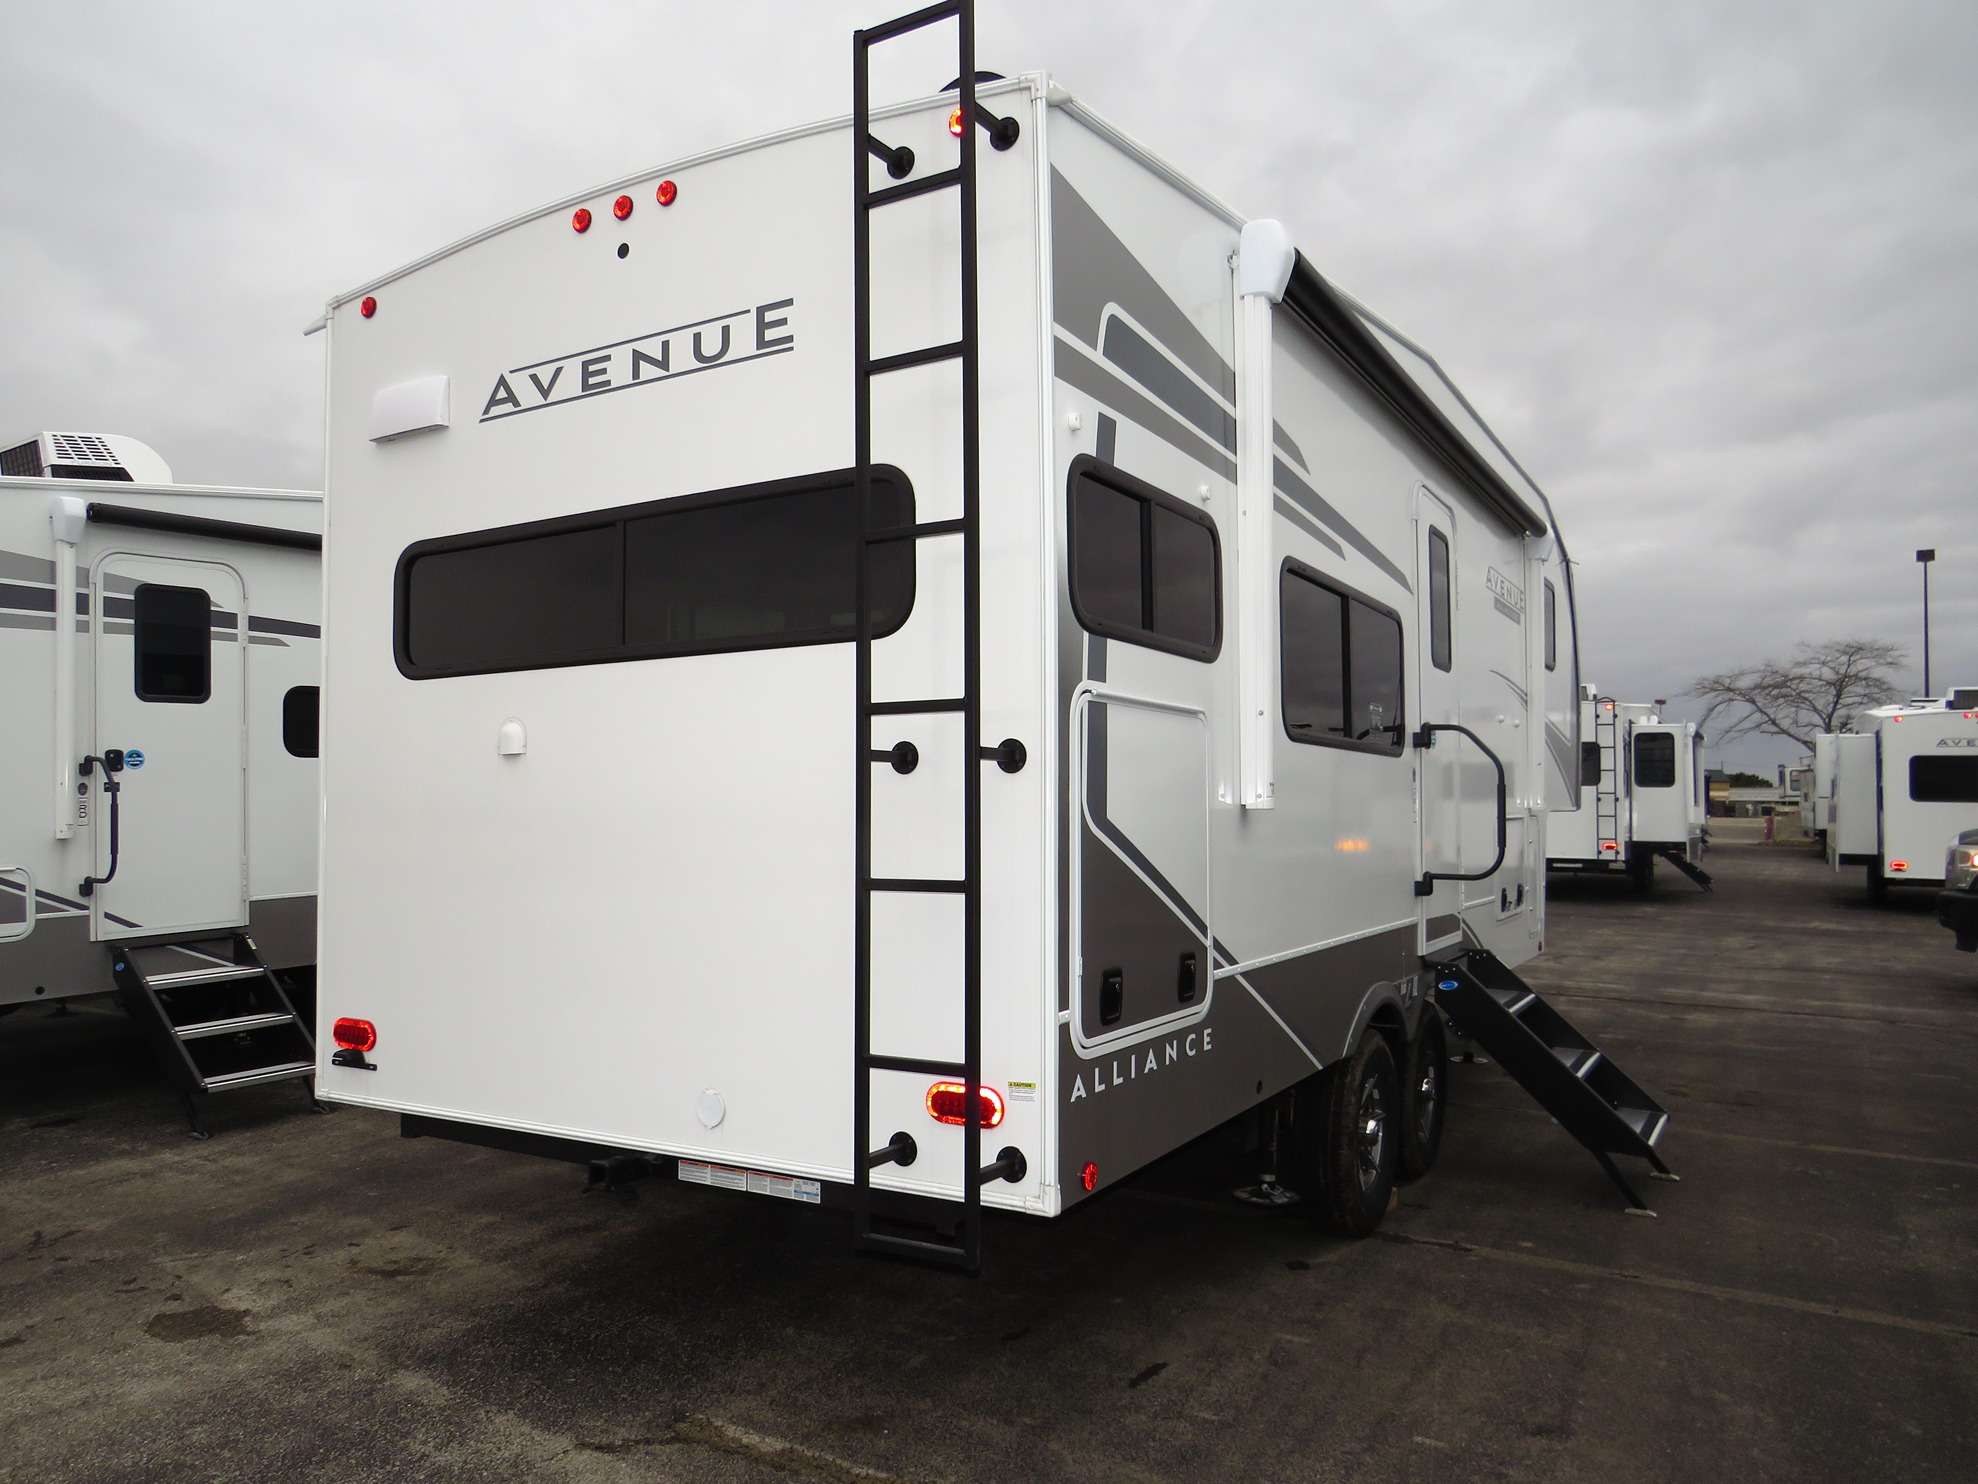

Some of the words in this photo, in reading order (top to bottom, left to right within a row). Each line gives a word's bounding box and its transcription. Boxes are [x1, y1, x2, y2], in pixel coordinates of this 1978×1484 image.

[482, 297, 794, 416] AVENUE
[1487, 566, 1525, 610] AVENUE
[1070, 1027, 1213, 1103] ALLIANCE
